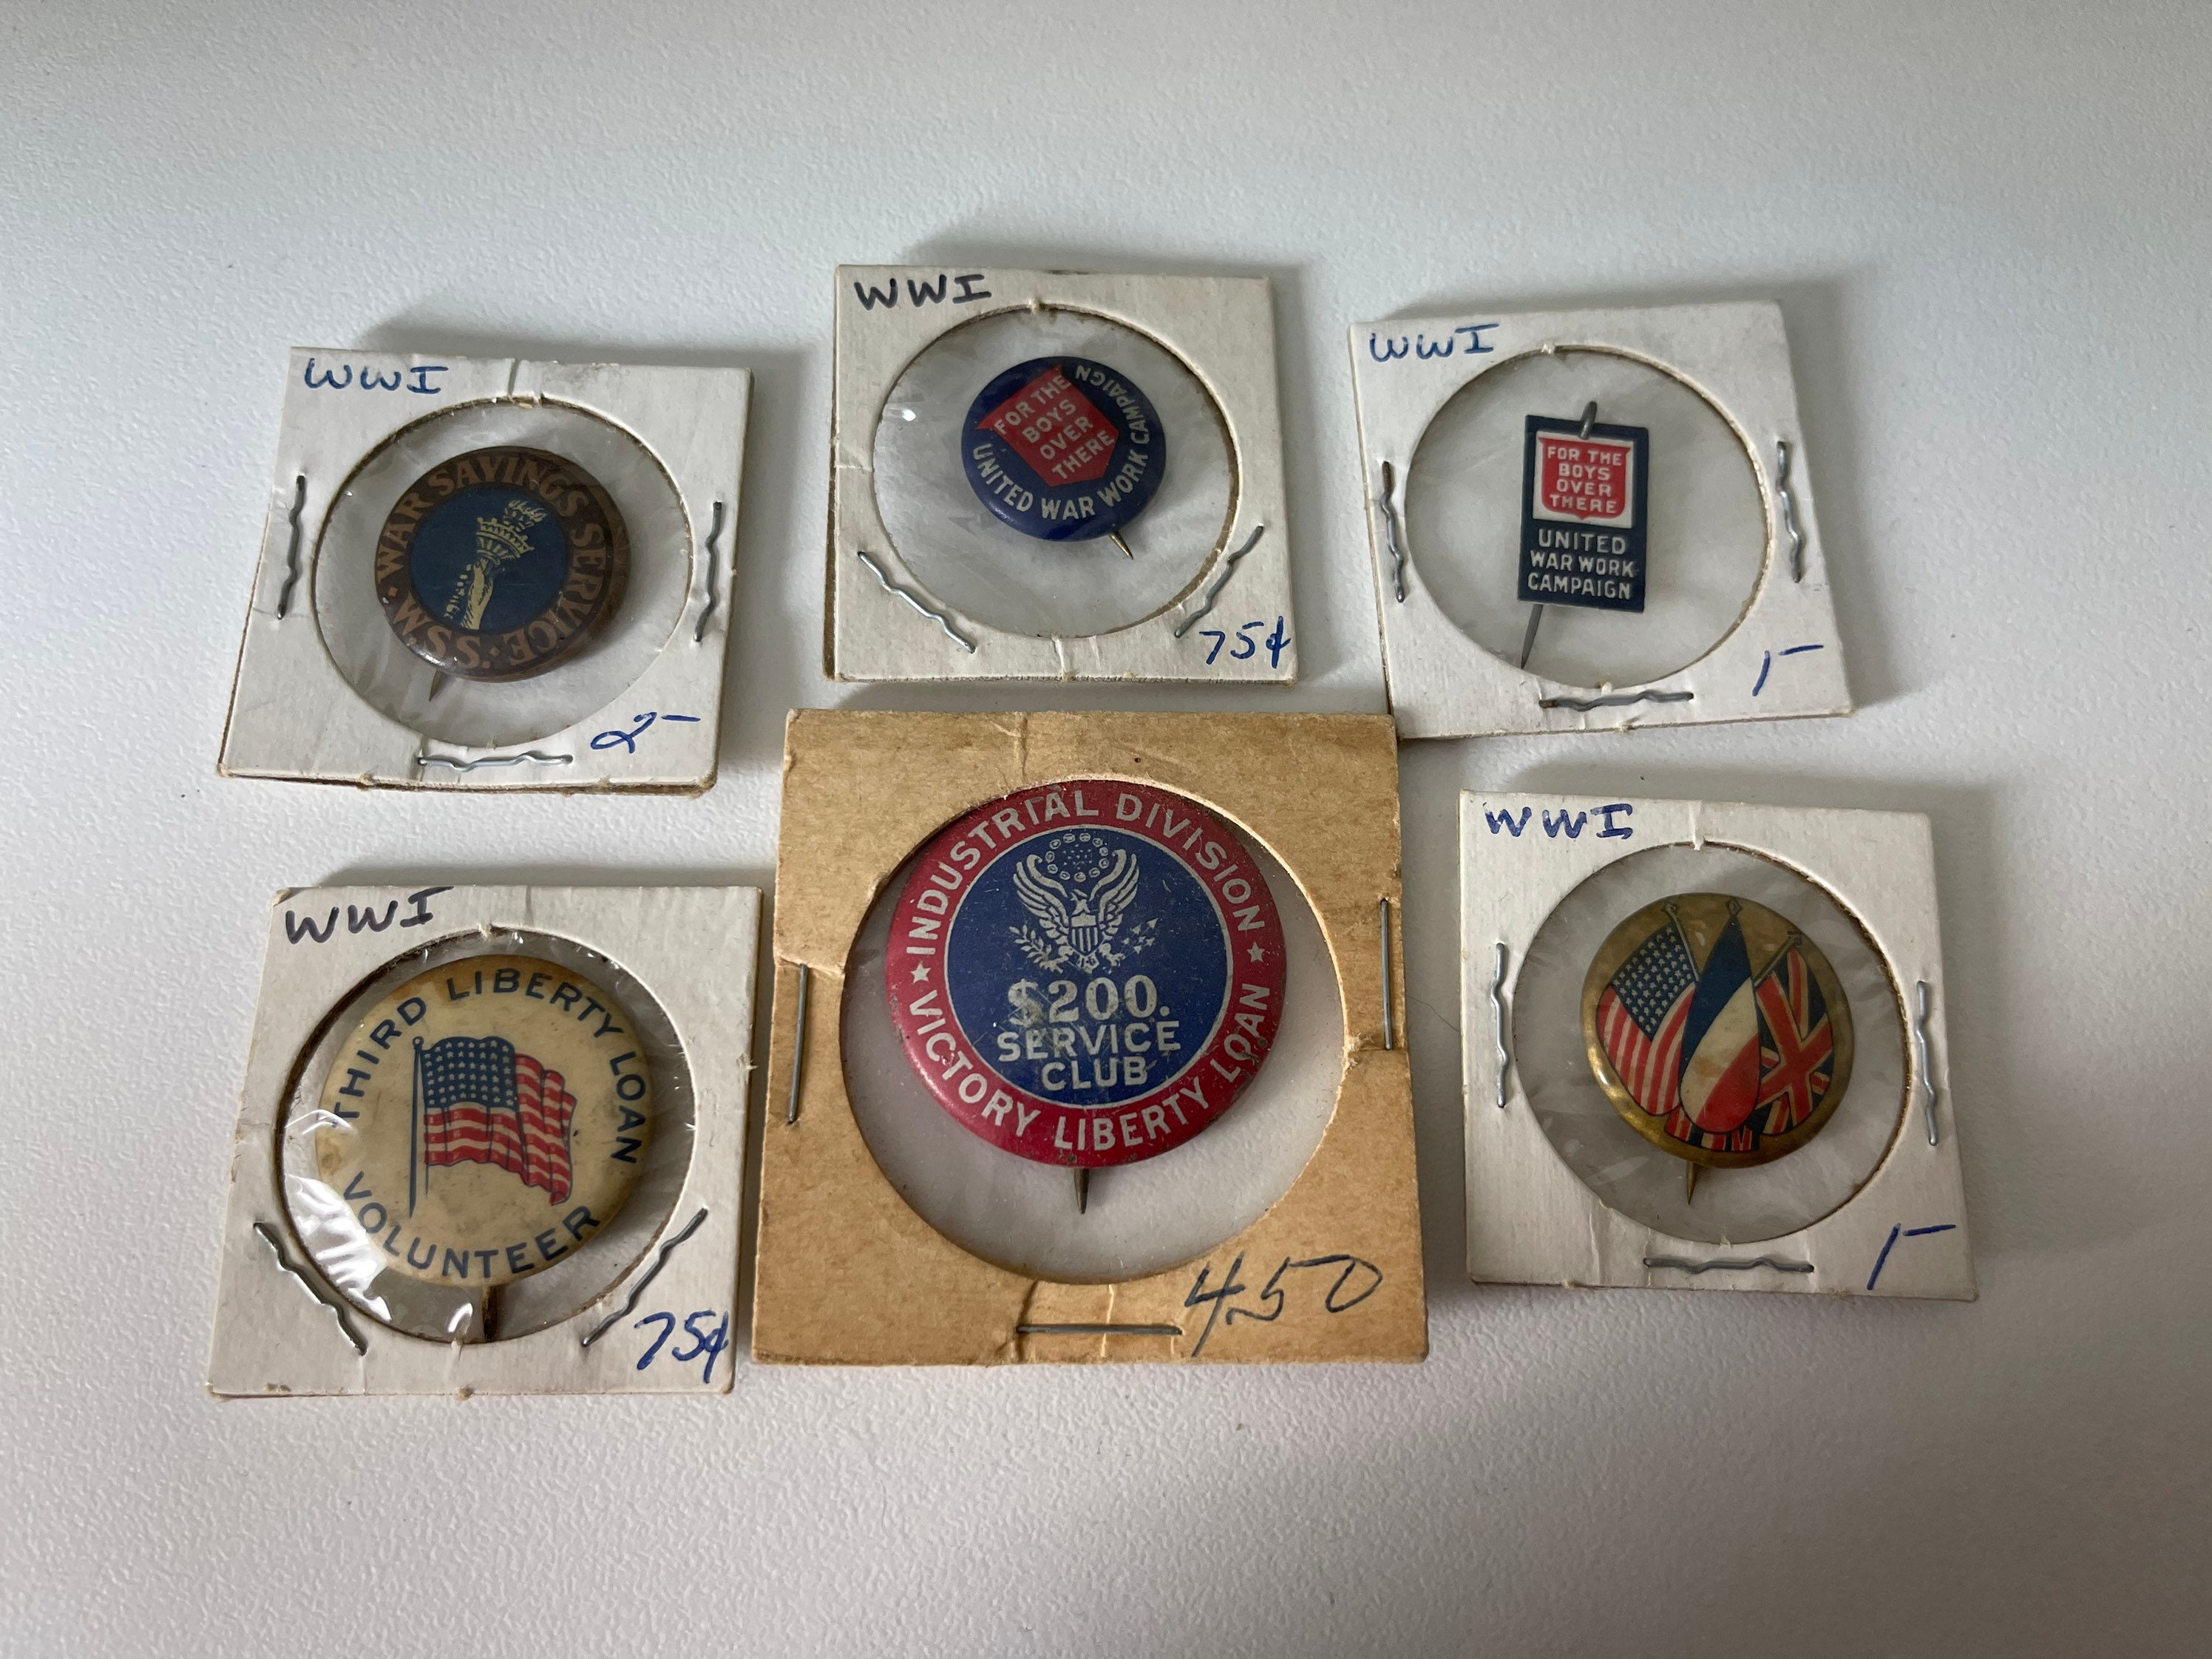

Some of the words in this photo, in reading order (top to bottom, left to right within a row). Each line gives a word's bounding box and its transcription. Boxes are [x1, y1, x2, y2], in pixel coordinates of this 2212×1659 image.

[854, 274, 992, 311] WWI
[1369, 323, 1500, 362] WWI
[305, 358, 449, 394] WWI
[994, 401, 1035, 435] FOR
[1031, 375, 1072, 404] THE
[1022, 399, 1076, 443] BOYS
[1075, 365, 1150, 444] CAMPAIGN
[1039, 416, 1093, 460] OVER
[1052, 430, 1115, 479] THERE
[1547, 447, 1580, 461] FOR
[1587, 449, 1622, 467] THE
[429, 456, 588, 518] SAVINGS
[973, 444, 1034, 512] UNITED
[1097, 449, 1148, 507] WORK
[1556, 480, 1612, 498] OVER
[1558, 463, 1610, 481] BOYS
[1041, 496, 1096, 520] WAR
[1550, 494, 1618, 514] THERE
[377, 492, 433, 583] WAR
[1538, 529, 1626, 555] UNITED
[1527, 572, 1632, 600] CAMPAIGN
[1530, 550, 1573, 571] WAR
[1578, 555, 1635, 578] WORK
[503, 523, 606, 665] SERVICE
[1482, 802, 1634, 840] WWI
[906, 790, 1099, 956] INDUSTRIAL
[1116, 793, 1265, 932] DIVISION
[285, 886, 454, 943] WWI
[997, 1020, 1181, 1062] SERVICE
[332, 997, 427, 1128] THIRD
[446, 968, 623, 1038] LIBERTY
[609, 1051, 646, 1164] LOAN
[909, 990, 1041, 1137] VICTORY
[1054, 1079, 1210, 1151] LIBERTY
[1210, 983, 1271, 1084] LOAN
[1042, 1056, 1148, 1091] CLUB
[343, 1171, 600, 1278] VOLUNTEER
